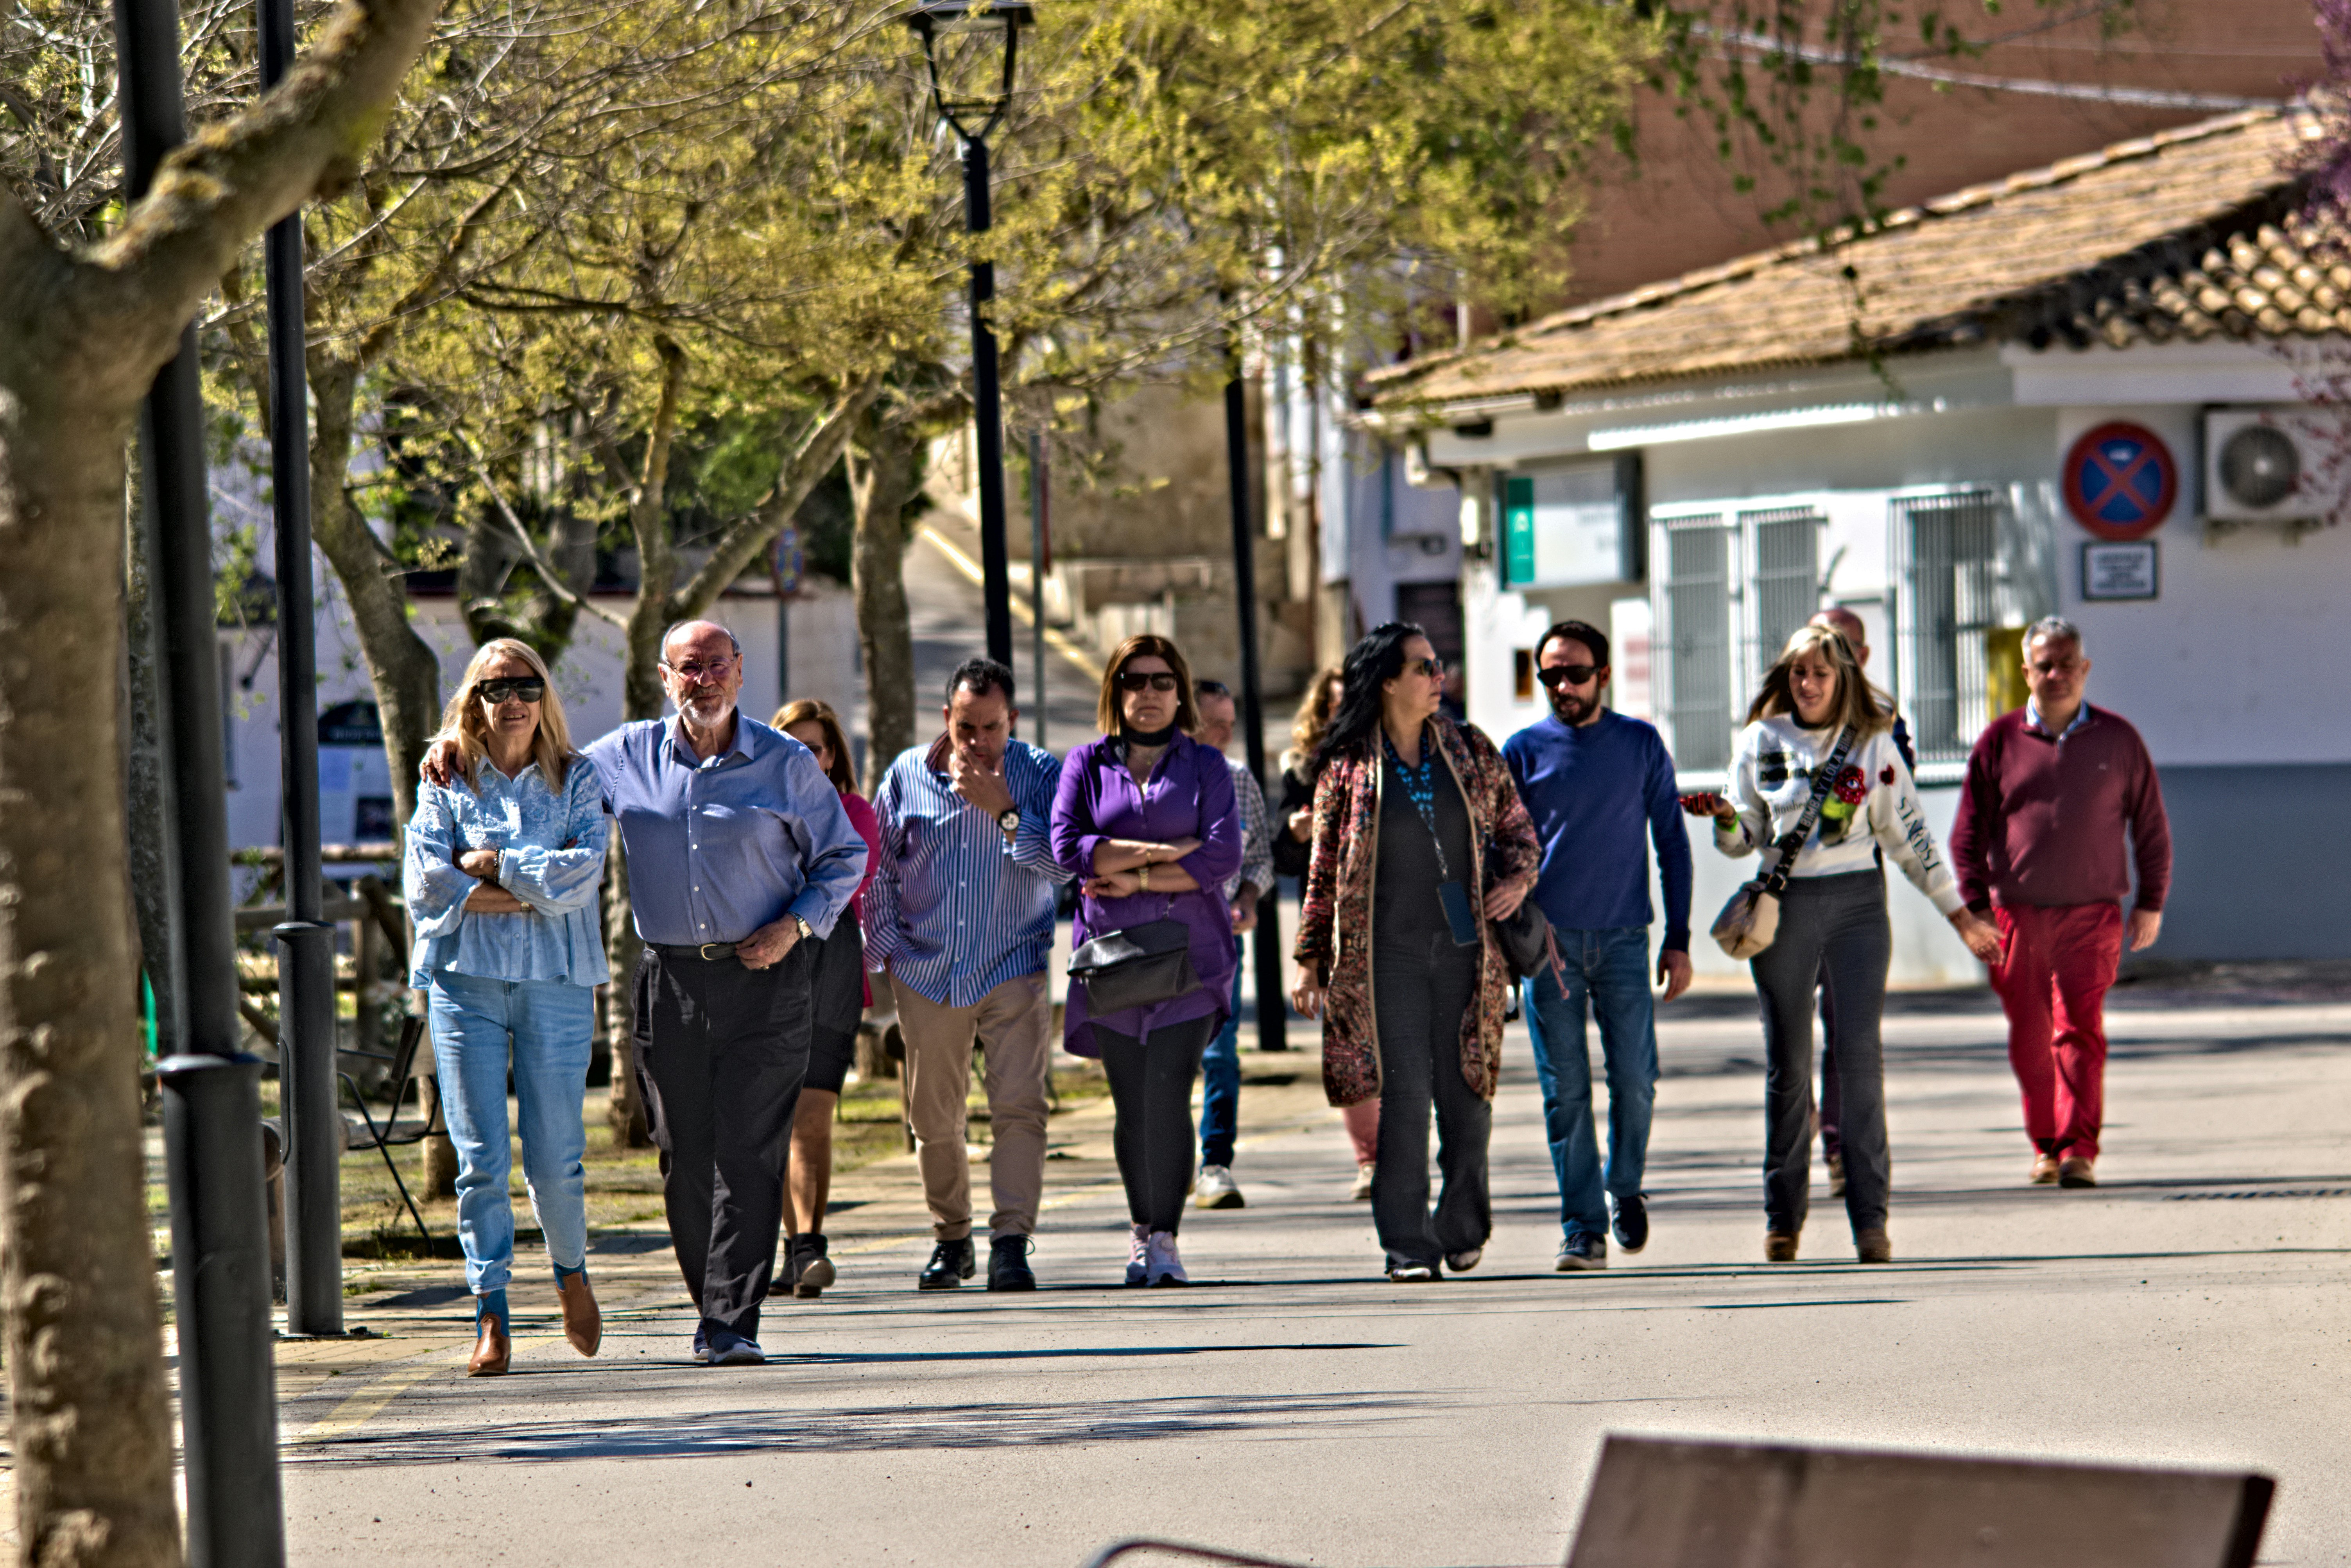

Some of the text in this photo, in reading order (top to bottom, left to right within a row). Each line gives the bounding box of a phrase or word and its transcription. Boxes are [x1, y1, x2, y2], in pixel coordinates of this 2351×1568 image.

[1822, 754, 1844, 782] LOLA
[1817, 778, 1829, 791] Y
[1800, 793, 1825, 827] BIMBA
